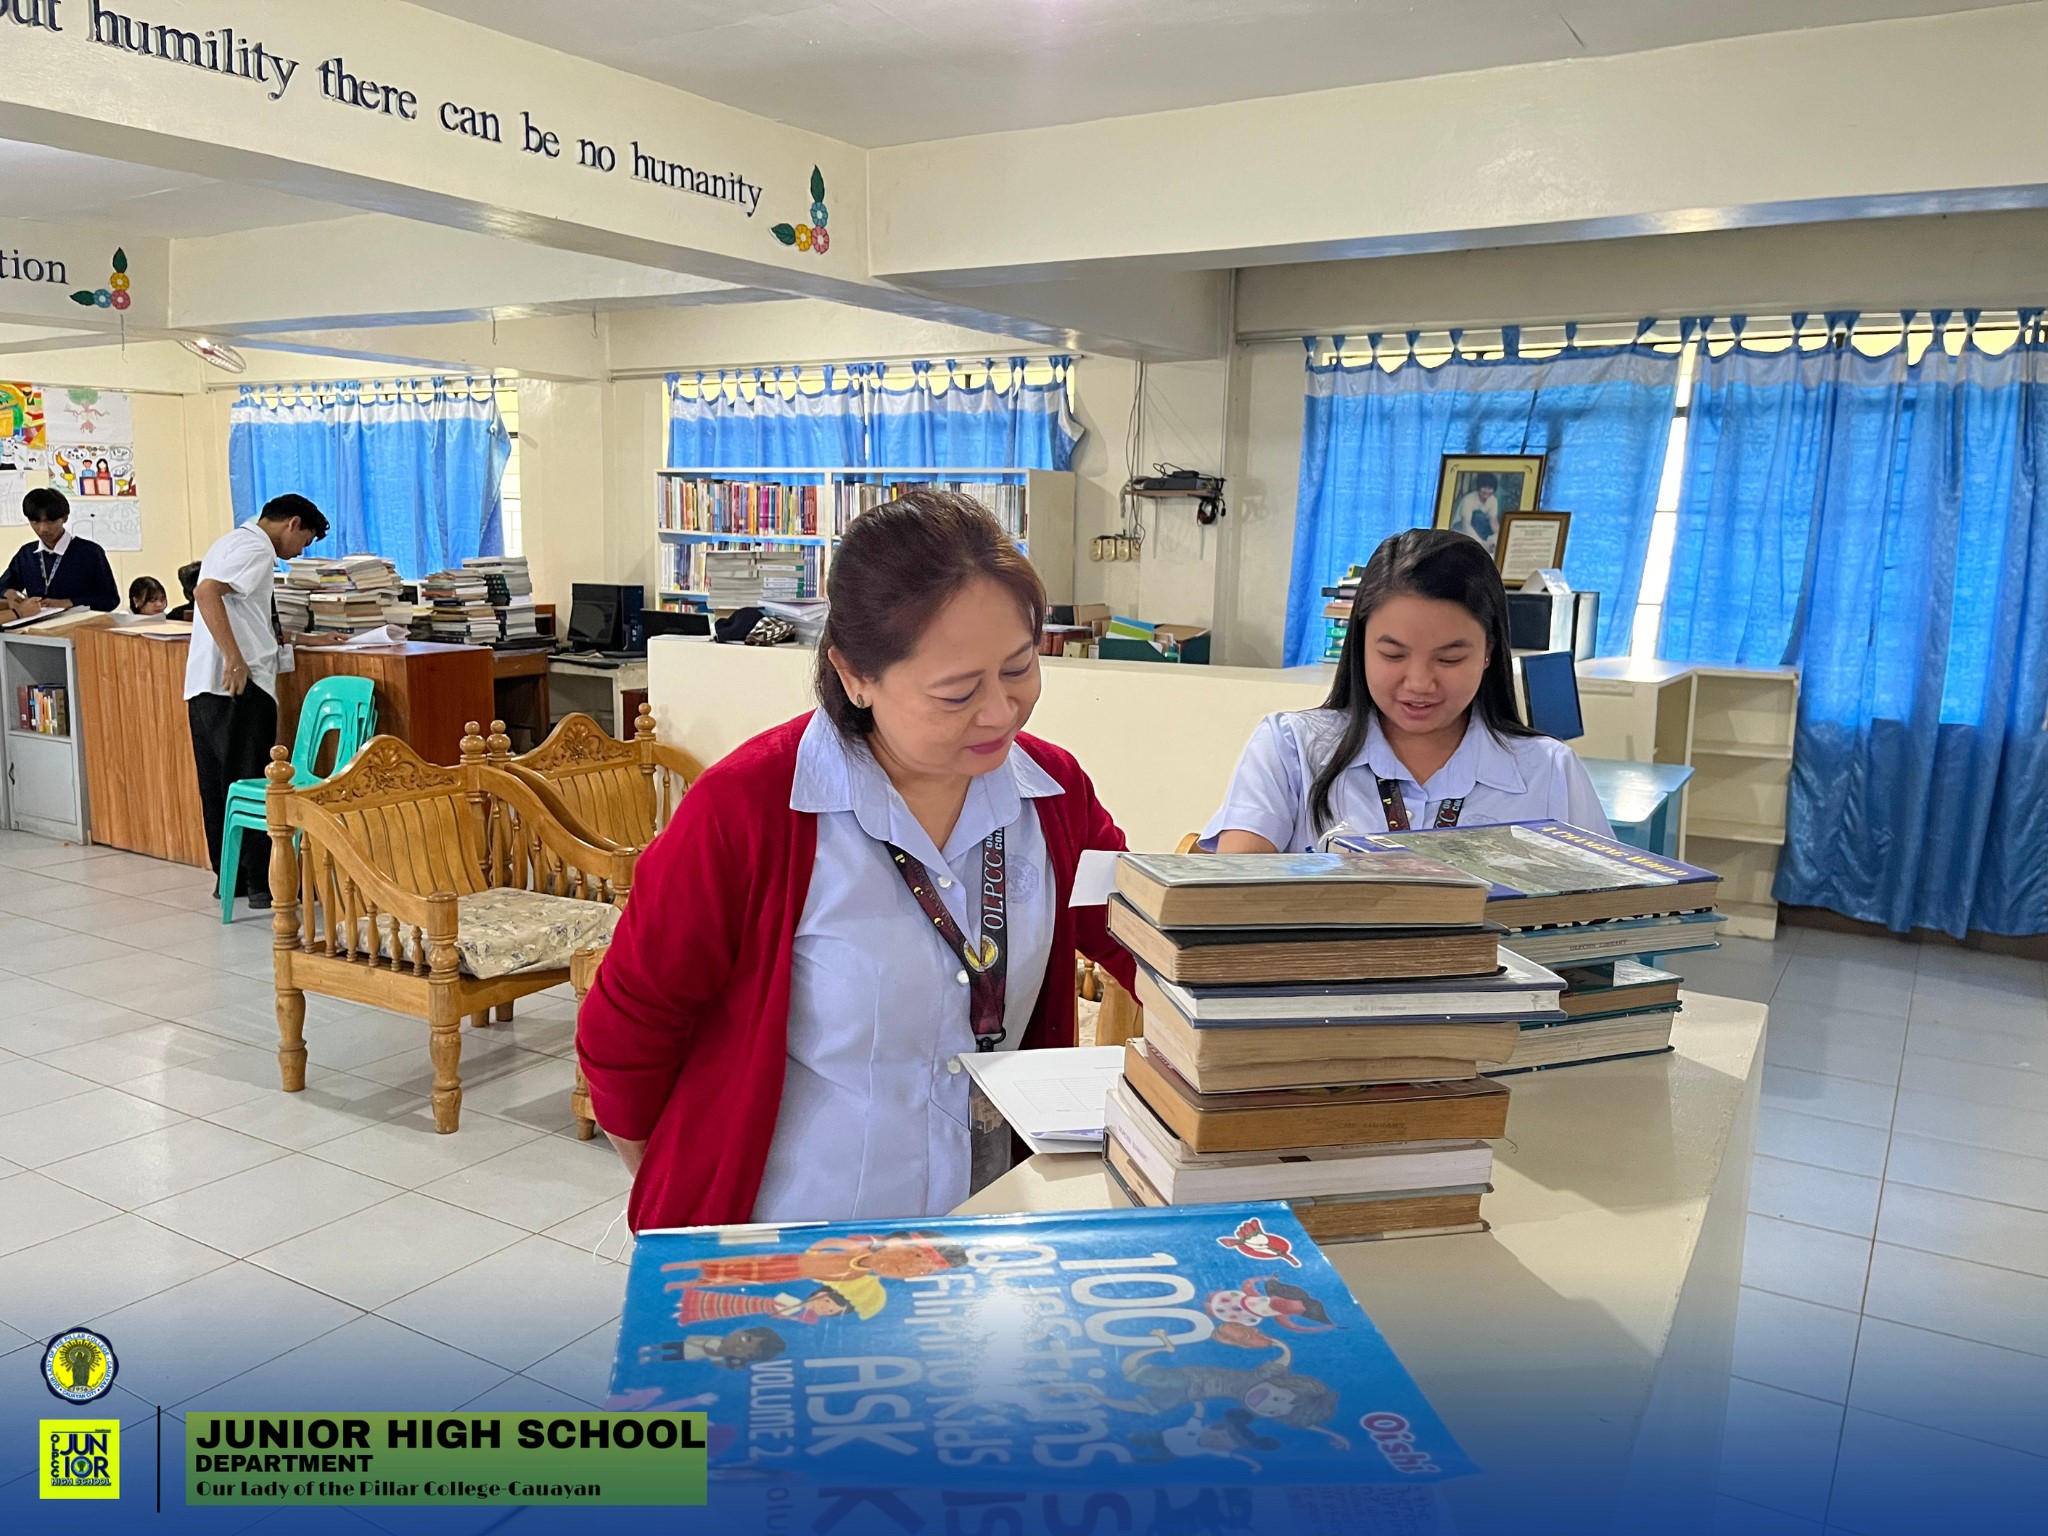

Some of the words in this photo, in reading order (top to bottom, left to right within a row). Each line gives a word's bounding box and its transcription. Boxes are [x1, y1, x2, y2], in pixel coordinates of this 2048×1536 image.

[0, 0, 62, 31] ut
[86, 0, 299, 100] humility
[316, 57, 418, 121] there
[439, 102, 502, 143] can
[520, 111, 560, 158] be
[576, 138, 616, 172] no
[630, 141, 763, 217] humanity
[983, 852, 1004, 930] OLPCC
[1626, 855, 1689, 876] WORLD
[1059, 1252, 1215, 1346] 100
[1360, 1412, 1441, 1474] Oishi
